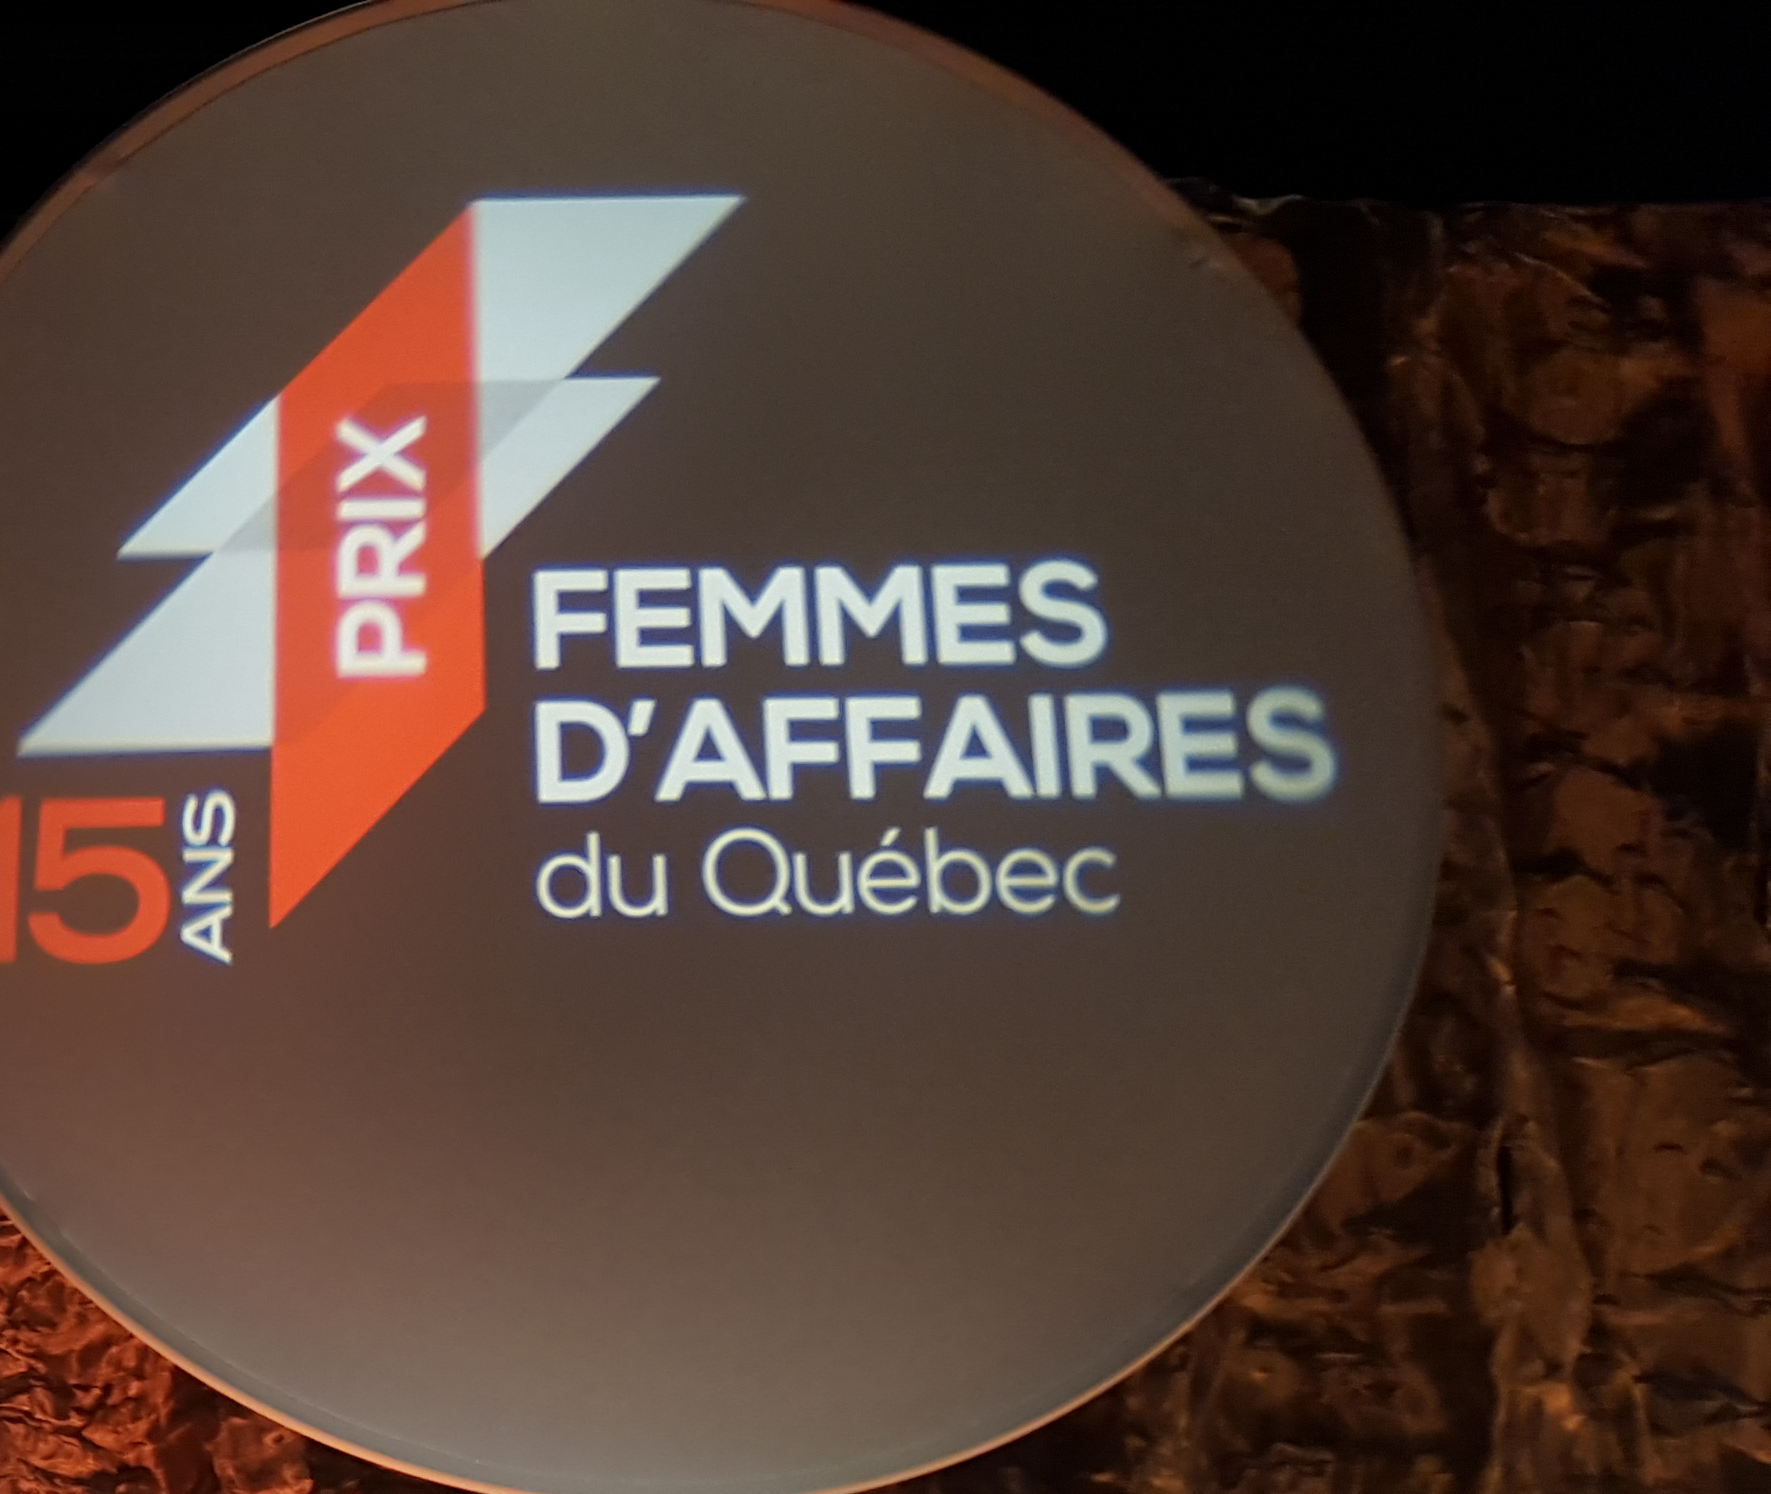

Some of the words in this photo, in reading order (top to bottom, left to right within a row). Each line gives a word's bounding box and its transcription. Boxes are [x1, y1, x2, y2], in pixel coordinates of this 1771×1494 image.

[333, 415, 429, 680] PRIX
[530, 559, 1109, 672] FEMMES
[532, 689, 1338, 804] D'AFFAIRES
[179, 788, 237, 965] ANS
[534, 830, 669, 920] du
[701, 826, 1122, 918] Québec
